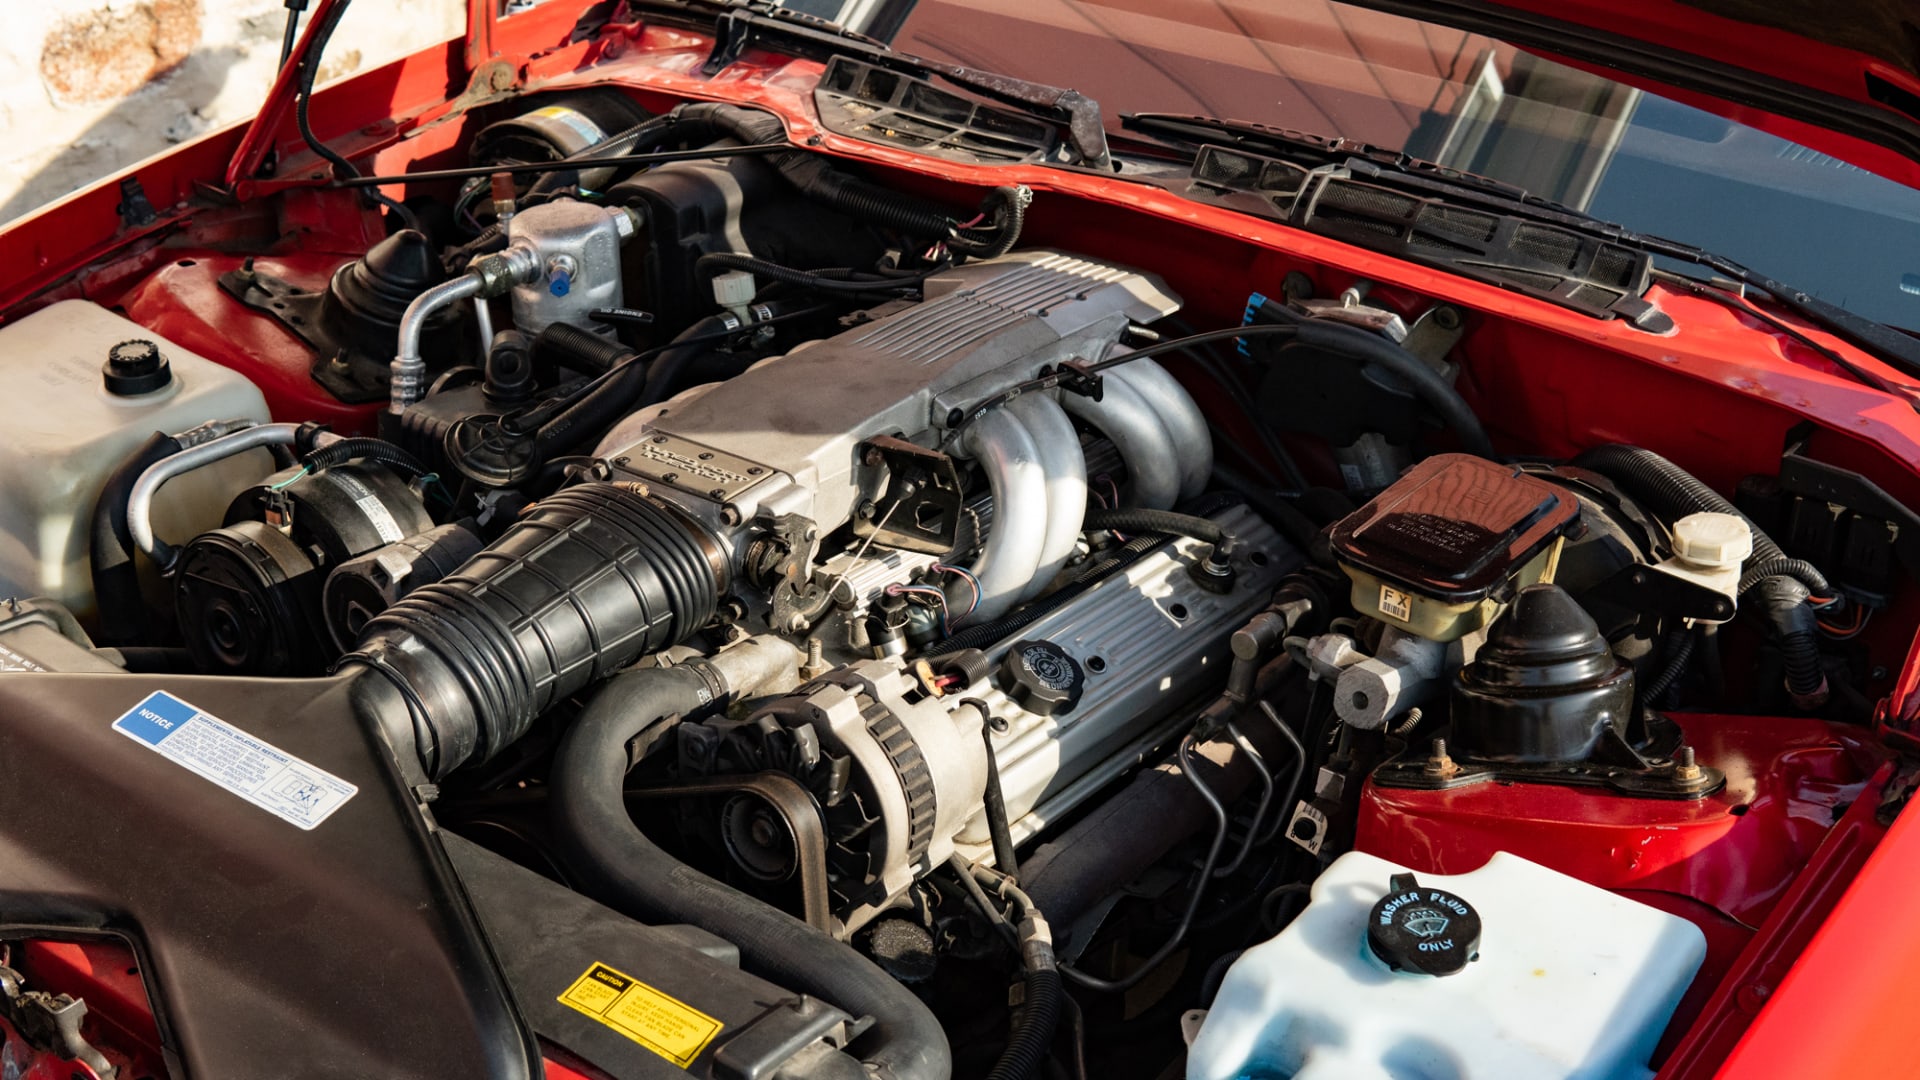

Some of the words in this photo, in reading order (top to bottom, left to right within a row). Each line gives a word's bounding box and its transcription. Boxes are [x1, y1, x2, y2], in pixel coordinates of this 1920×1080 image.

[613, 309, 643, 318] ENGINE
[1384, 590, 1394, 601] F
[1397, 595, 1407, 608] X
[138, 708, 174, 730] NOTICE
[196, 716, 235, 736] SUPPLEMENTAL
[232, 734, 262, 750] INFLATABLE
[260, 747, 289, 763] RESTRAINT
[1380, 892, 1420, 925] WASHER
[1430, 892, 1468, 915] FLUID
[1418, 939, 1454, 952] ONLY
[596, 971, 624, 987] CAUTION
